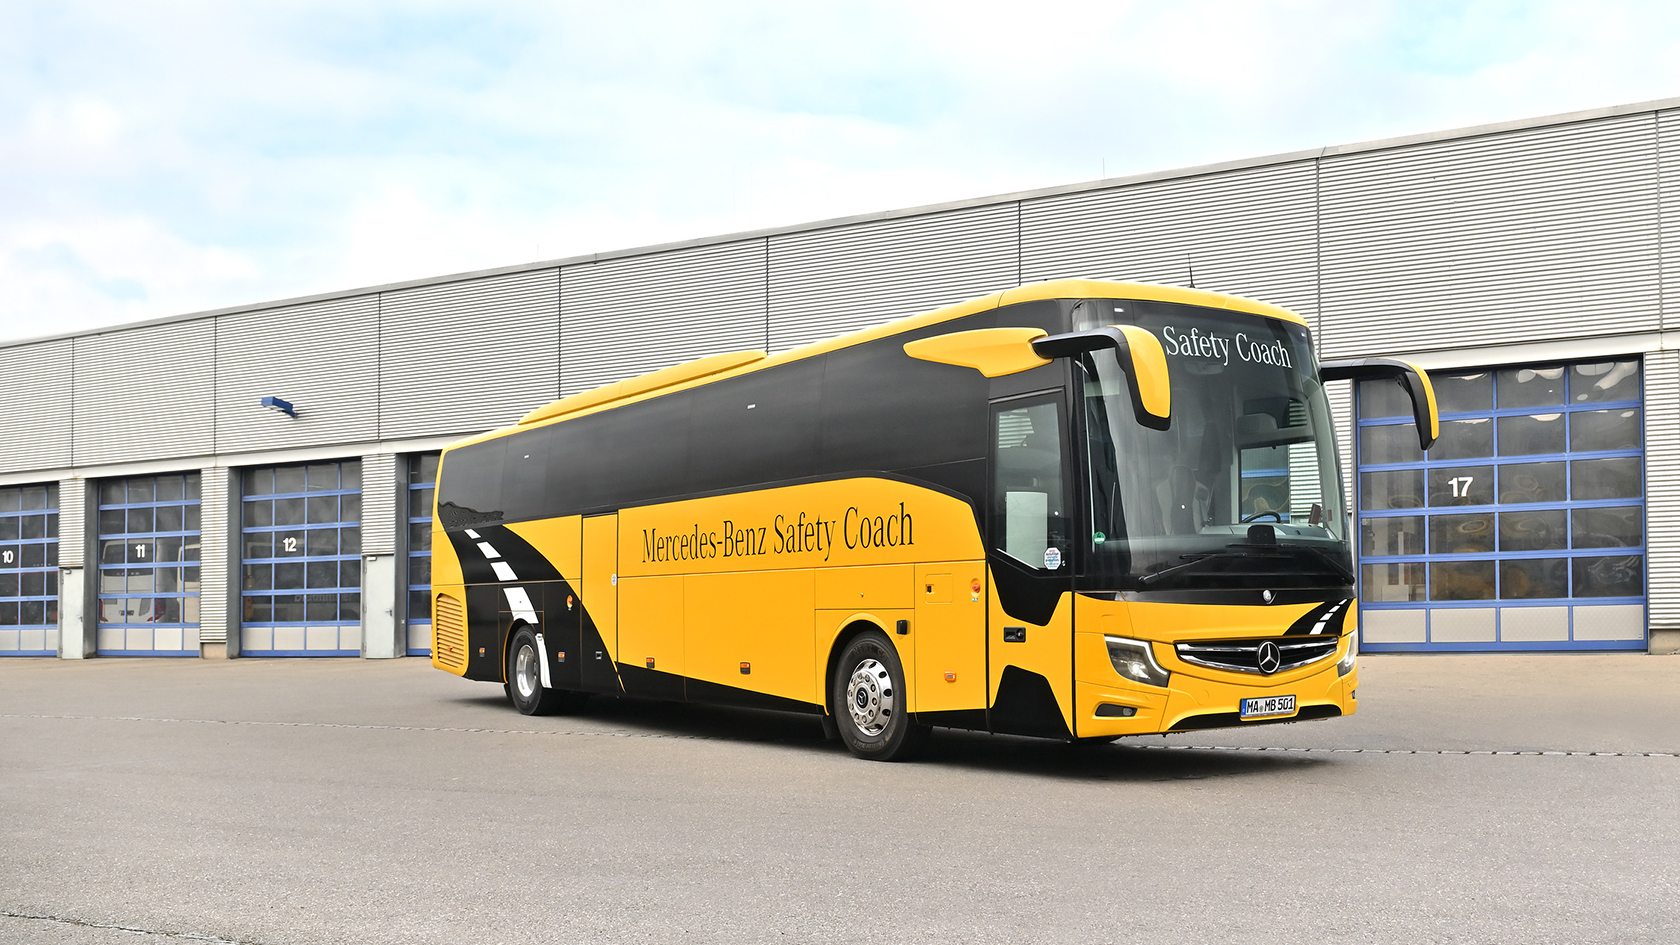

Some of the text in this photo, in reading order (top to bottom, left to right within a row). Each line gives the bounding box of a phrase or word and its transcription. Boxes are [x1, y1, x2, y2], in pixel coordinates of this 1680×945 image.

[1162, 325, 1293, 369] Safety Coach
[1447, 476, 1474, 498] 17
[642, 501, 915, 563] Mercedes-Benz Safety Coach
[135, 544, 146, 558] 11
[282, 537, 297, 552] 12
[2, 550, 14, 564] 10
[1246, 697, 1293, 713] MA MB 501
